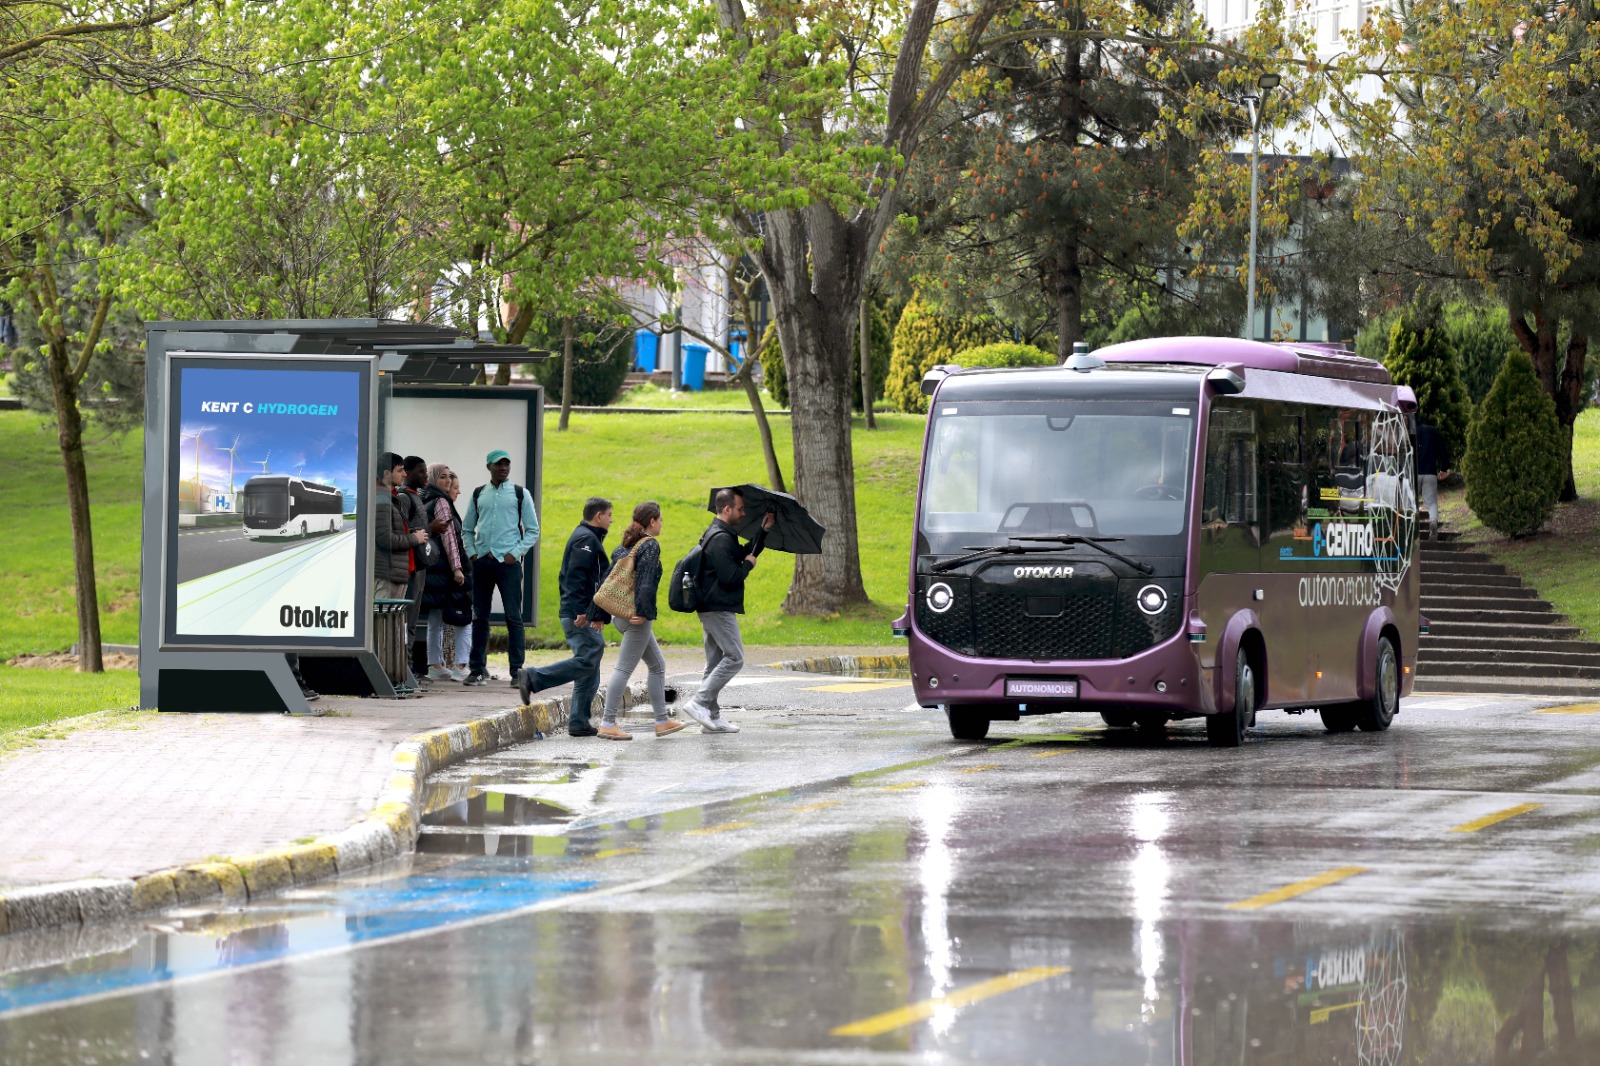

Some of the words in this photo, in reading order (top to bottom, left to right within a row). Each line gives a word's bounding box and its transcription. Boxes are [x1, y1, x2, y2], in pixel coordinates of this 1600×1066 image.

[201, 401, 239, 413] KENT
[243, 402, 253, 414] C
[257, 403, 338, 416] HYDROGEN
[1313, 523, 1373, 556] e-CENTRO
[1013, 566, 1074, 579] OTOKAR
[1299, 575, 1382, 606] autonomous
[280, 605, 349, 629] Otokar
[1009, 684, 1074, 694] AUTONOMOUS
